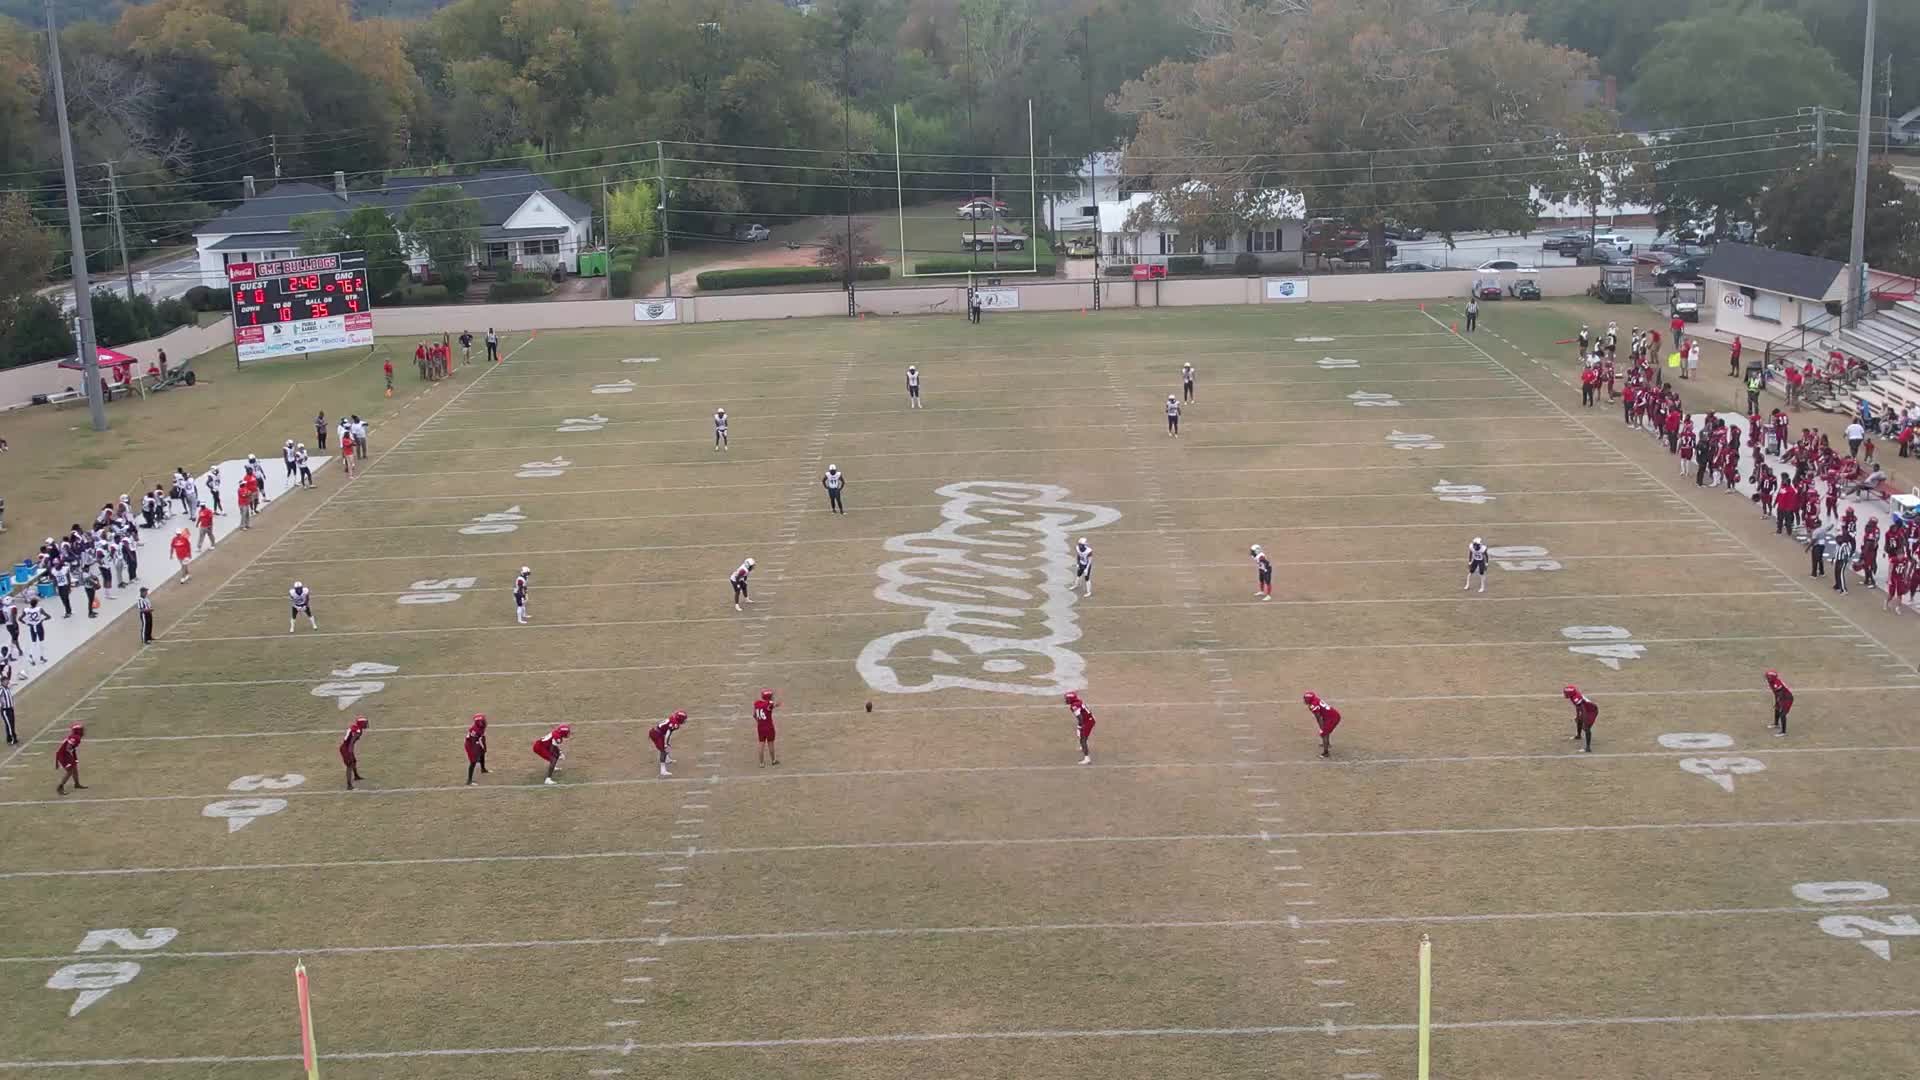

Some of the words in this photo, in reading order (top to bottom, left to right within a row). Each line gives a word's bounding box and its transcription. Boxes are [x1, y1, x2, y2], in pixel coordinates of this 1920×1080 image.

[259, 264, 281, 276] GMC
[283, 257, 337, 274] BULLDOGS
[335, 272, 354, 281] GMC
[240, 280, 268, 291] GUEST
[289, 275, 318, 291] 2:42
[337, 280, 353, 293] 76
[241, 305, 260, 313] DOWN
[311, 303, 329, 318] 35
[348, 300, 358, 312] 4
[1723, 295, 1745, 308] GMC
[1485, 545, 1562, 571] 50
[397, 576, 478, 604] 50
[856, 481, 1122, 696] Bulldogs
[1561, 625, 1648, 660] 40
[311, 662, 400, 697] 40
[1657, 732, 1766, 775] 30
[202, 773, 305, 818] 30
[1792, 881, 1920, 938] 20
[46, 927, 179, 990] 20
